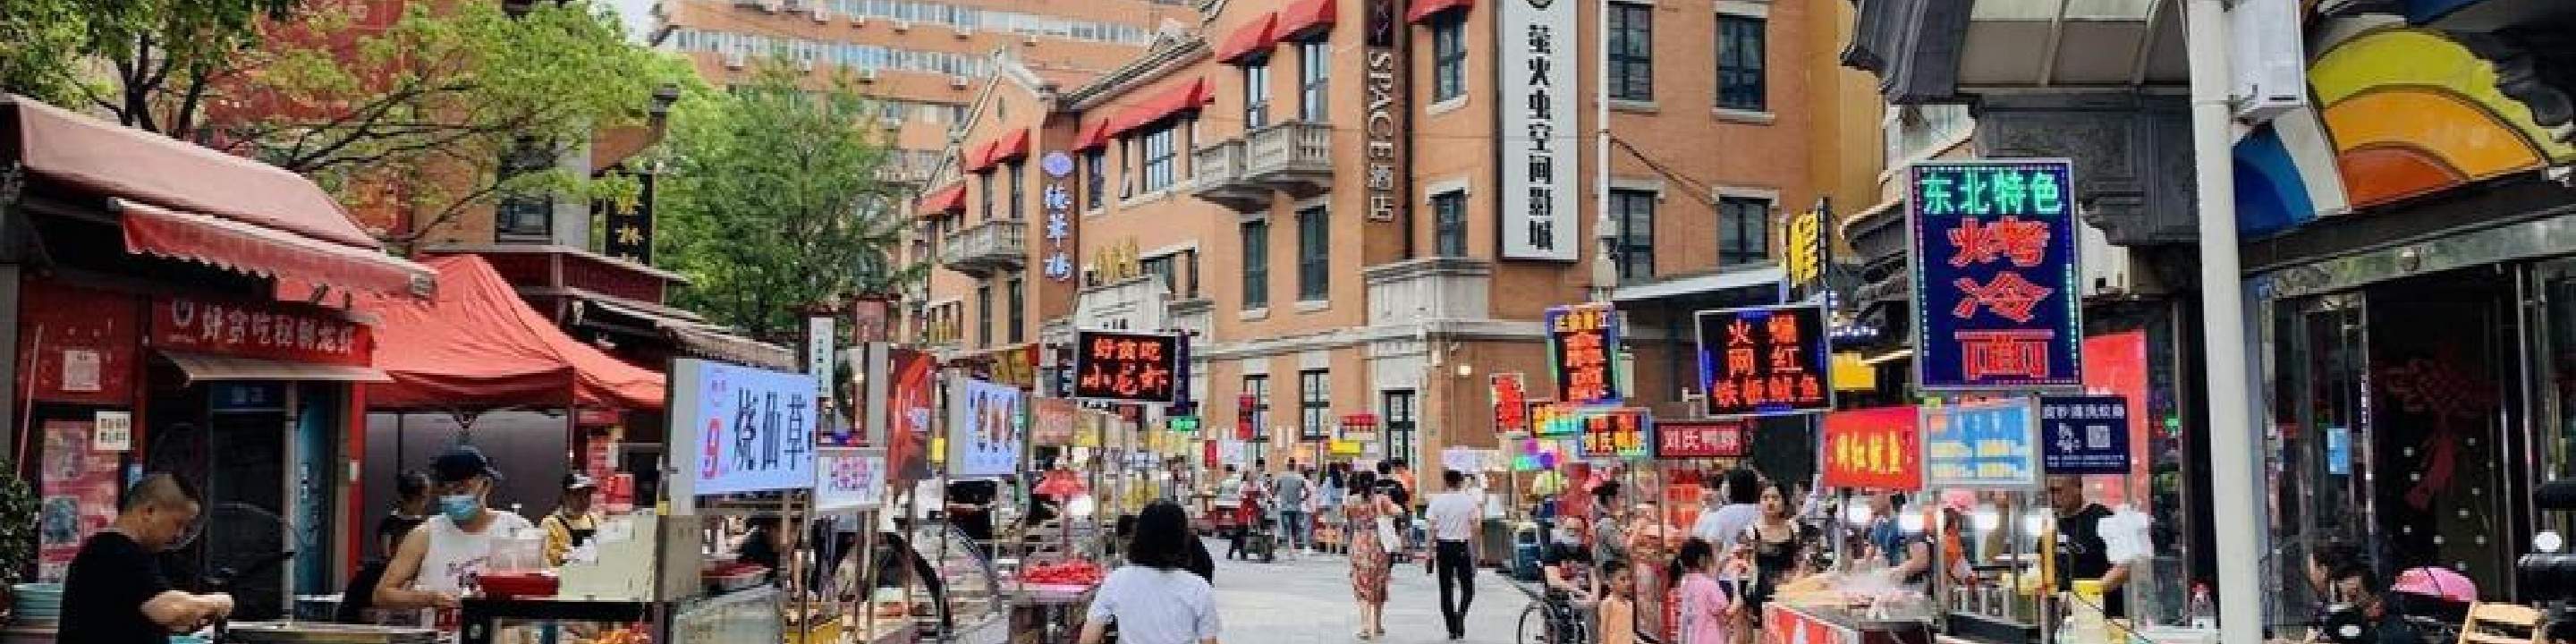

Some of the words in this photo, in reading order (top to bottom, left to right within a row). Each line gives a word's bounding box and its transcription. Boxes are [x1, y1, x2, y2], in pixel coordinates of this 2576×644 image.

[1920, 167, 2063, 215] 东北特色
[1728, 314, 1797, 347] 火爆
[1093, 338, 1162, 360] 好贪吃
[1728, 345, 1804, 377] 网红
[1080, 362, 1168, 396] 小龙虾
[1713, 374, 1824, 408] 铁板鱿鱼
